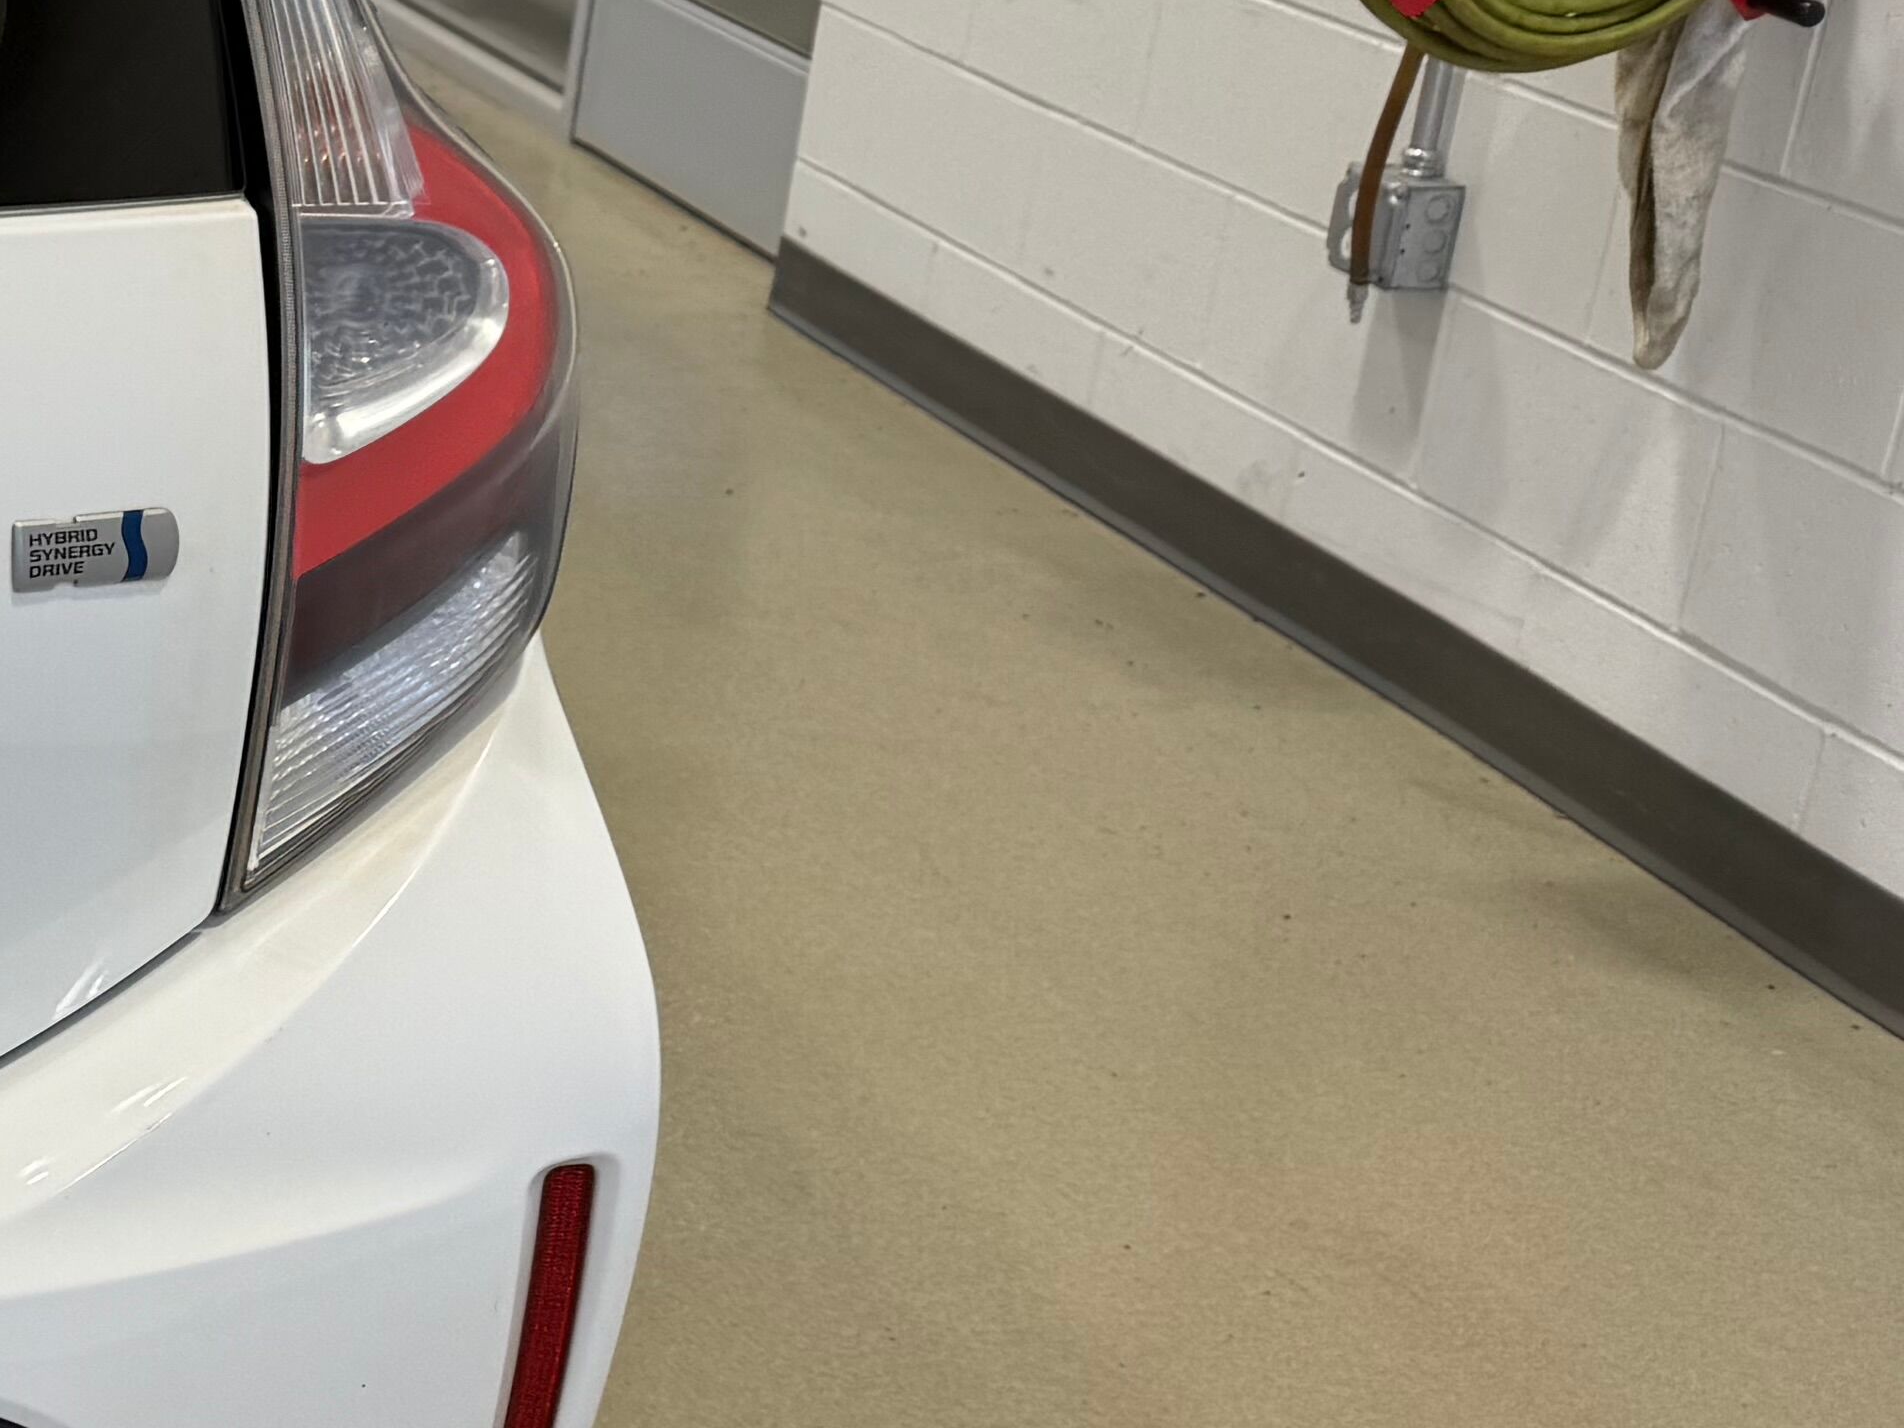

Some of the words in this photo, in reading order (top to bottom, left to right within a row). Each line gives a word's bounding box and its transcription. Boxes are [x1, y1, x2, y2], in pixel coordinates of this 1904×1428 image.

[29, 528, 98, 547] HYBRID
[29, 542, 116, 563] SYNERGY
[29, 560, 85, 579] DRIVE
